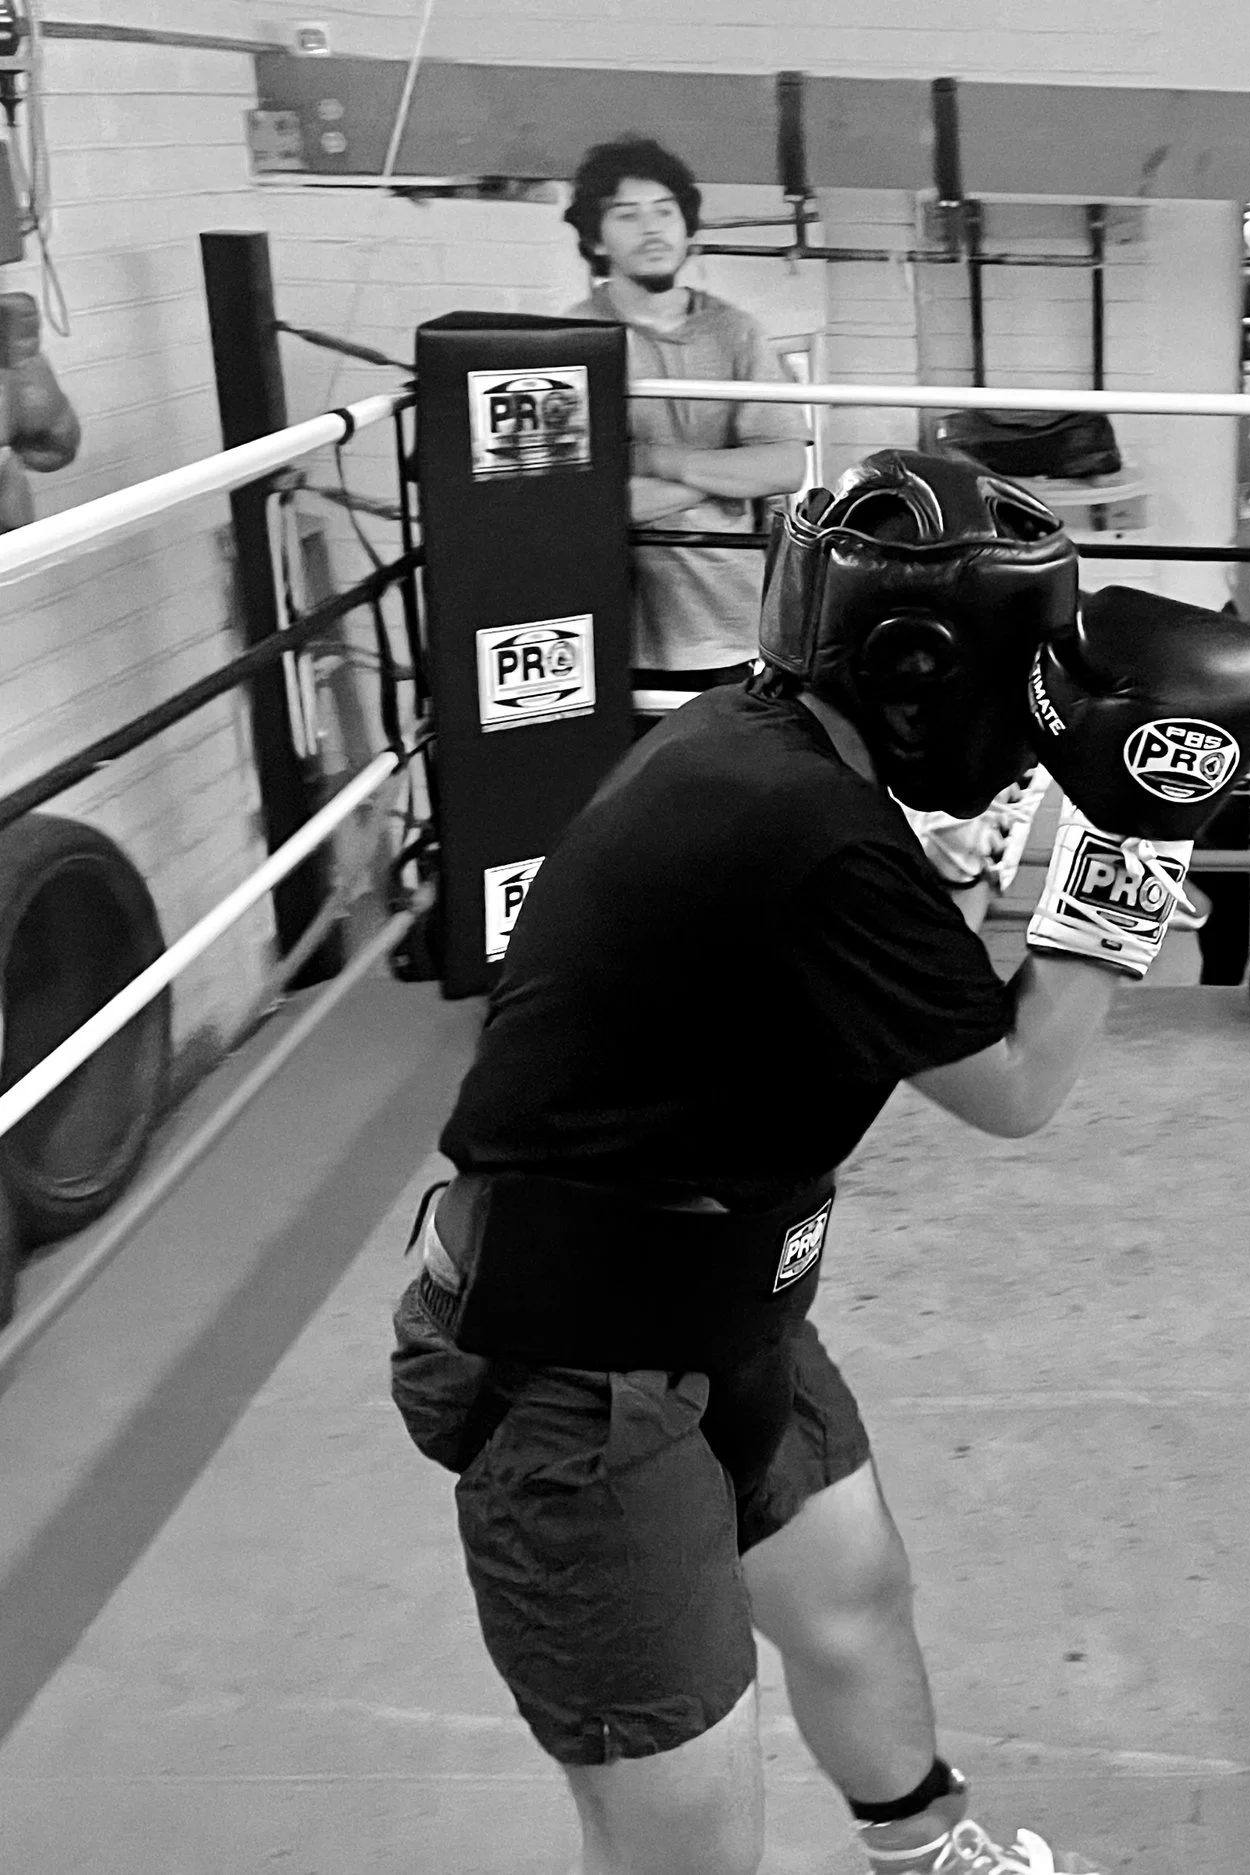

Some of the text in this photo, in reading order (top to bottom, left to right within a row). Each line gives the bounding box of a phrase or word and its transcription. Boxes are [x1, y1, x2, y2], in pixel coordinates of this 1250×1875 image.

[1137, 731, 1225, 780] PRO
[1166, 726, 1222, 749] PBS
[1081, 860, 1168, 912] PRO
